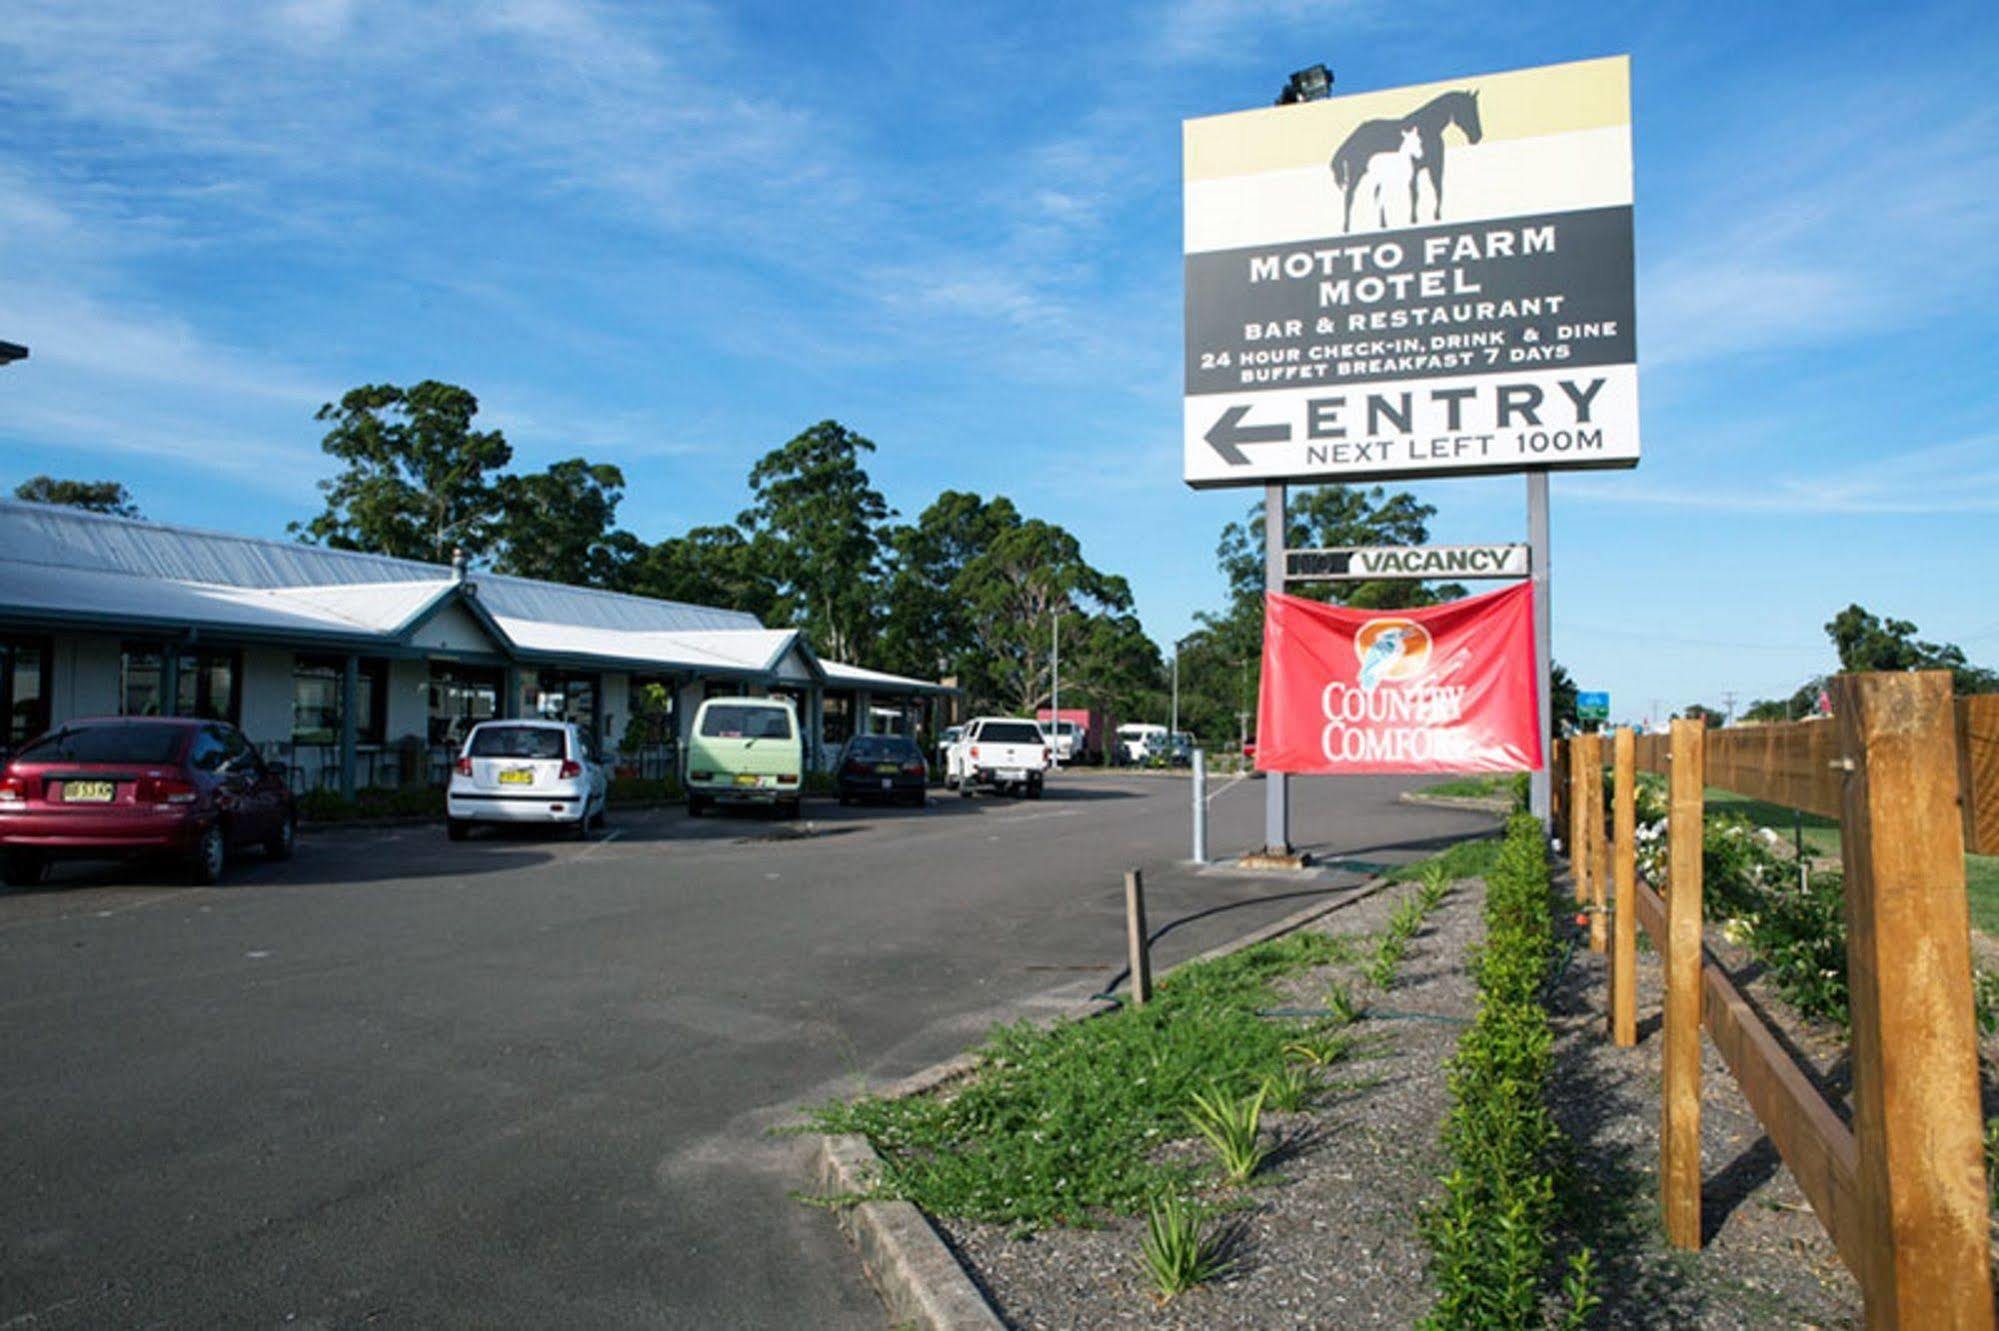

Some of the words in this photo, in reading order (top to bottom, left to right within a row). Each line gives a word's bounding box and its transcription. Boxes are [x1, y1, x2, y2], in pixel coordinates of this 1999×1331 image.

[1250, 243, 1403, 283] MOTTO
[1425, 226, 1556, 266] FARM
[1319, 268, 1481, 308] MOTEL
[1244, 319, 1303, 341] BAR
[1315, 317, 1335, 334] &
[1348, 296, 1565, 331] RESTAURANT
[1200, 352, 1231, 370] 24
[1239, 348, 1300, 366] HOUR
[1430, 331, 1505, 351] DRINK
[1523, 327, 1540, 343] &
[1557, 321, 1618, 340] DINE
[1240, 363, 1329, 383] BUFFET
[1337, 352, 1474, 377] BREAKFAST
[1484, 348, 1500, 365] 7
[1509, 344, 1571, 363] DAYS
[1306, 378, 1607, 440] ENTRY
[1307, 441, 1394, 465] NEXT
[1409, 435, 1494, 460] LEFT
[1517, 428, 1604, 454] 100M
[1361, 550, 1512, 573] VACANCY
[1321, 720, 1469, 763] COMFO
